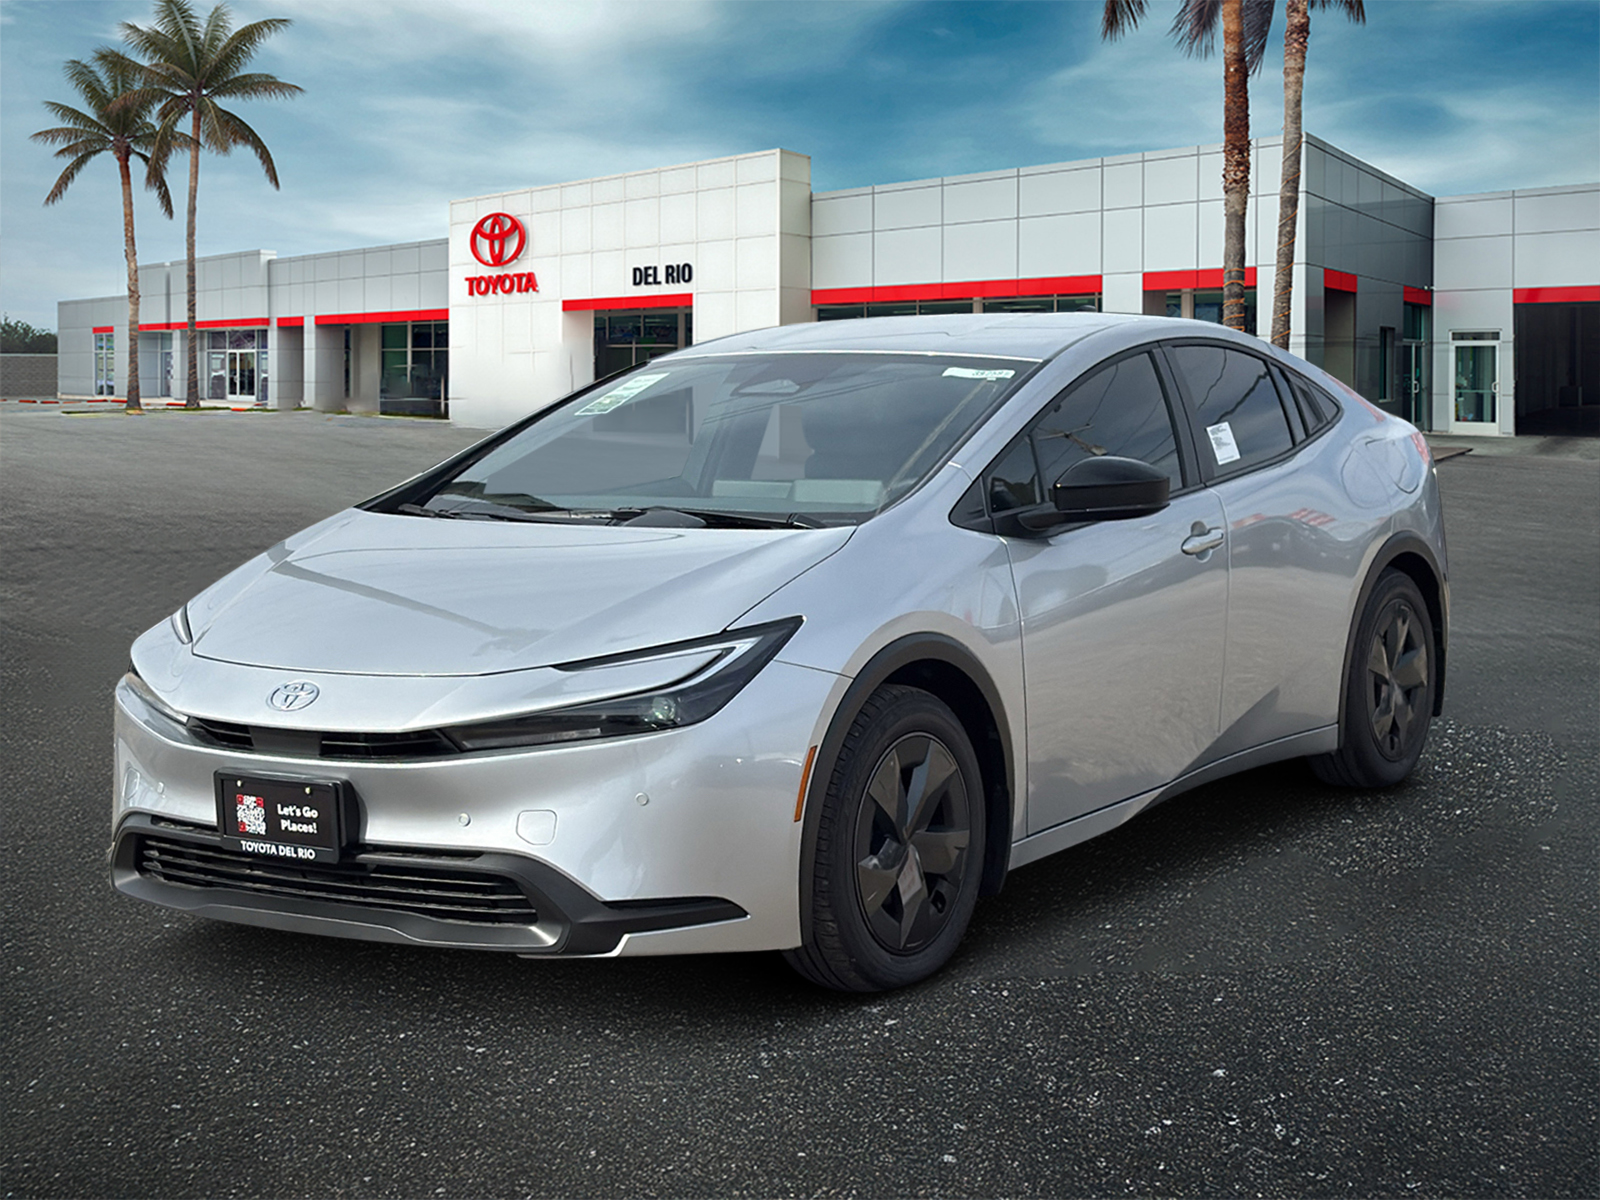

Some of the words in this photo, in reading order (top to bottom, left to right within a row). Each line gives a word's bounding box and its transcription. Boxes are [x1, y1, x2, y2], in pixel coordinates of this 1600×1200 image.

[465, 272, 538, 296] TOYOTA
[632, 266, 661, 286] DEL
[665, 263, 693, 284] RIO
[277, 803, 301, 817] Let's
[302, 806, 319, 819] Go
[281, 819, 317, 834] Places!
[240, 840, 277, 855] TOYOTA
[278, 845, 297, 858] DEL
[297, 847, 316, 860] RIO
